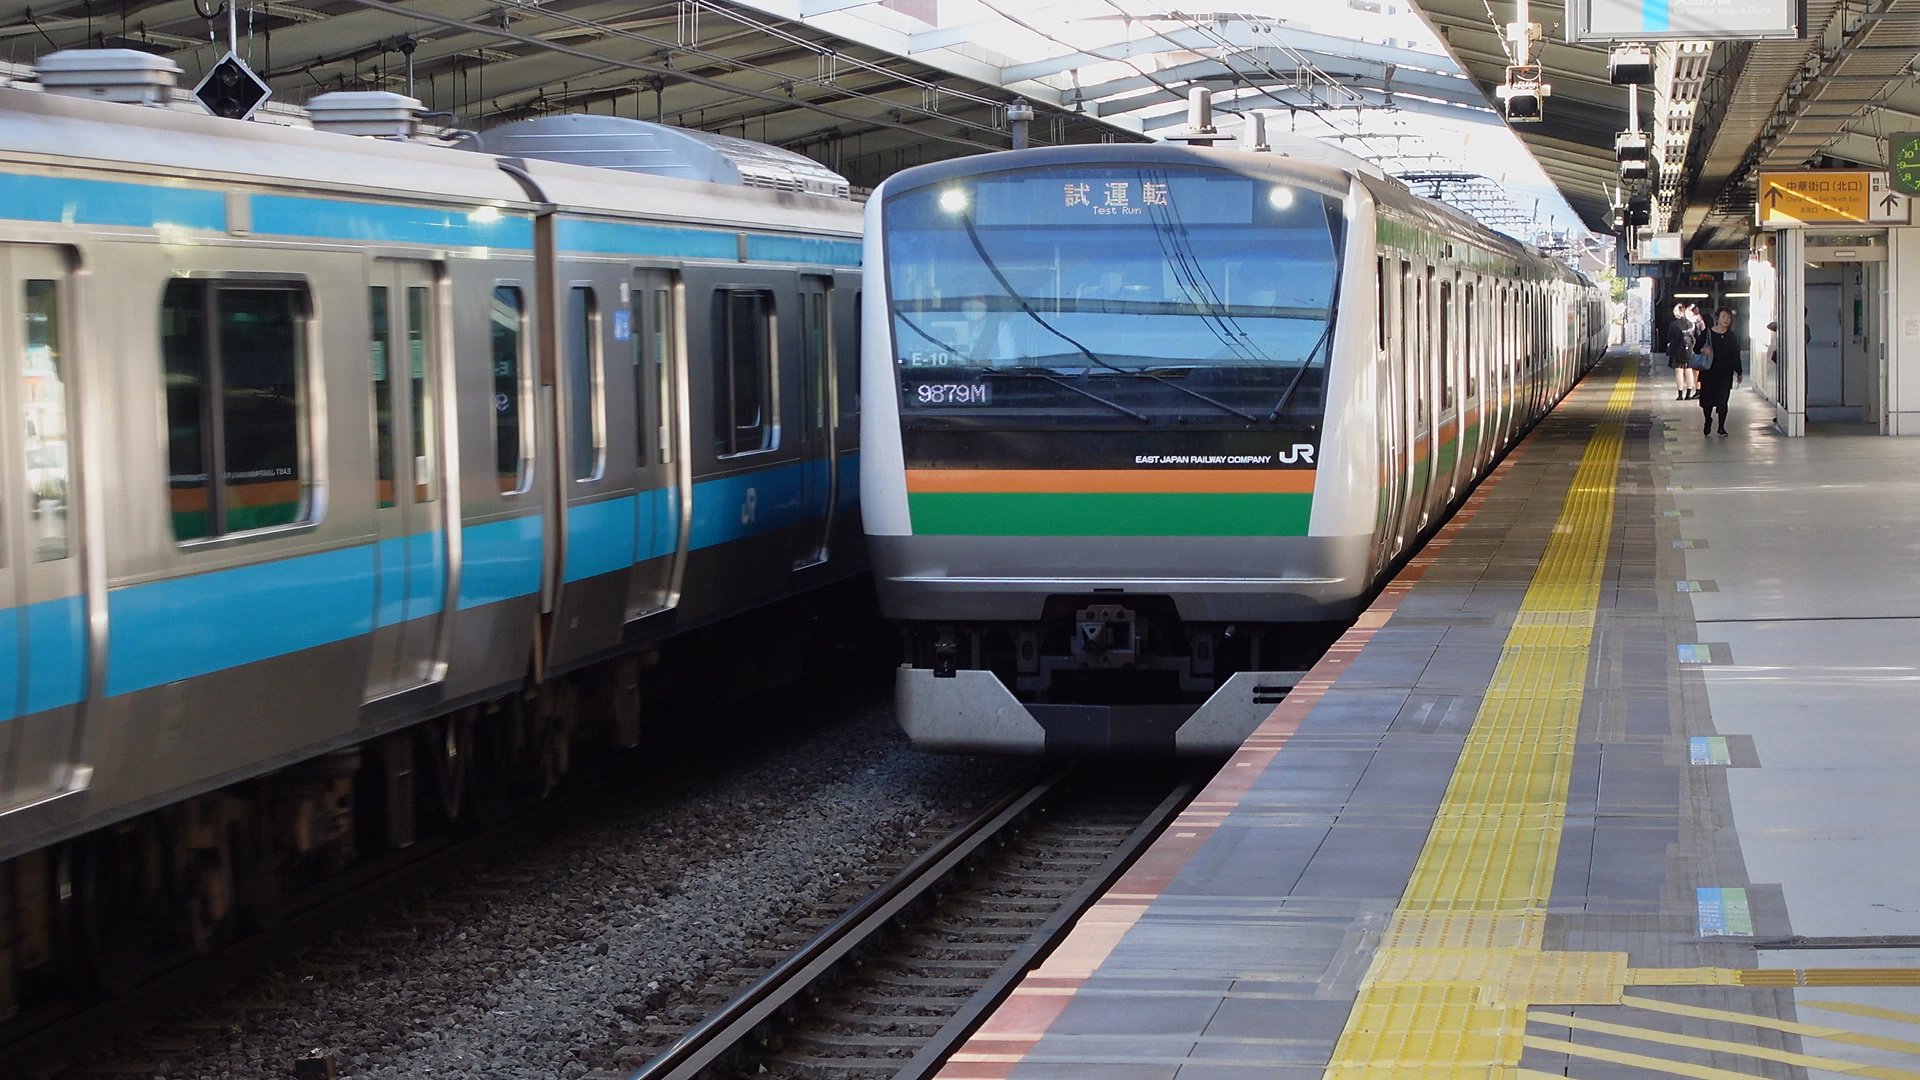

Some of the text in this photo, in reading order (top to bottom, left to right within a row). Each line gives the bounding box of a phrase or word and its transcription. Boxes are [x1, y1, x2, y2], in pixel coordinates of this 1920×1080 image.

[1904, 150, 1914, 158] 10
[1064, 182, 1168, 207] 試運転
[1092, 206, 1142, 215] Test Run
[912, 352, 948, 366] E-10
[917, 384, 986, 403] 9879M
[1135, 455, 1271, 464] EAST JAPAN RAILWAY COMPANY
[1279, 443, 1315, 464] JR
